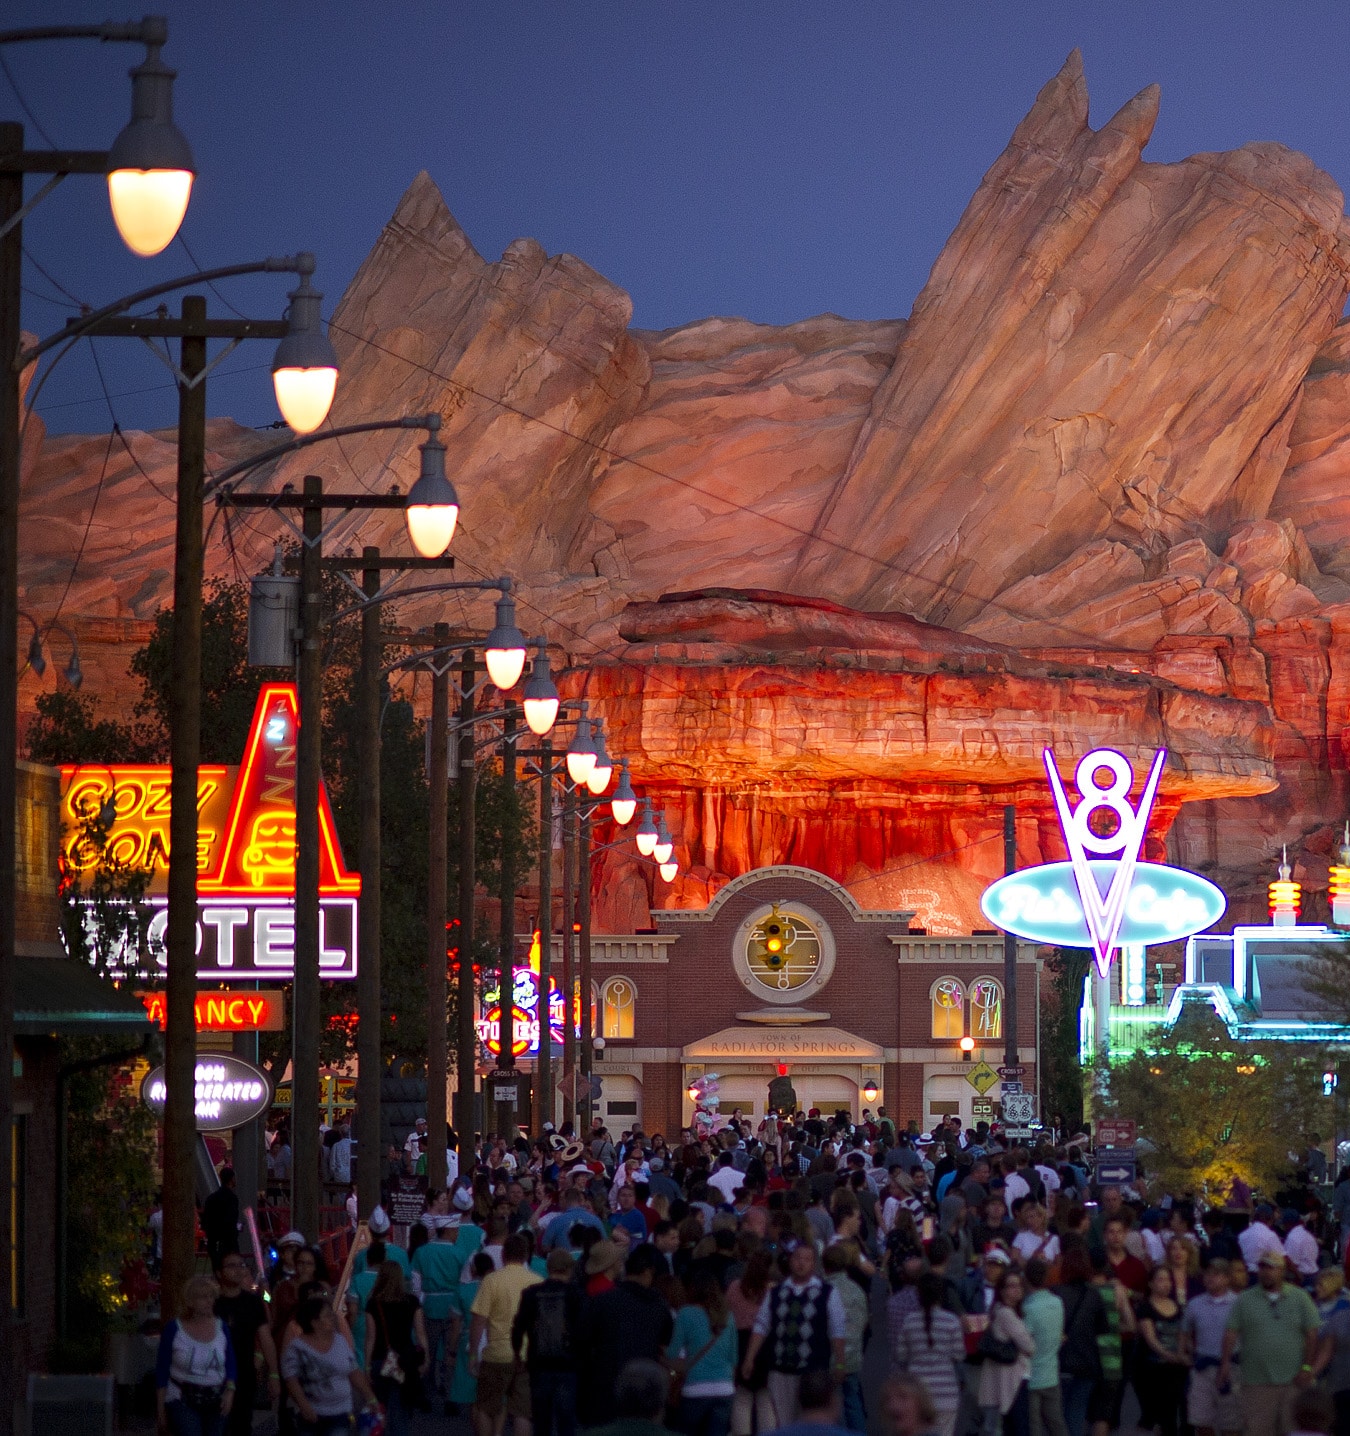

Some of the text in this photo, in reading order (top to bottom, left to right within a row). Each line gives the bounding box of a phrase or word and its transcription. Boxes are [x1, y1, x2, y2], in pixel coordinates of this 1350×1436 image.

[149, 998, 264, 1025] ANCY
[476, 1020, 540, 1041] TIES
[711, 1042, 857, 1053] RADIATOR SPRINGS
[195, 1064, 225, 1082] 00%
[1007, 1103, 1031, 1120] 66
